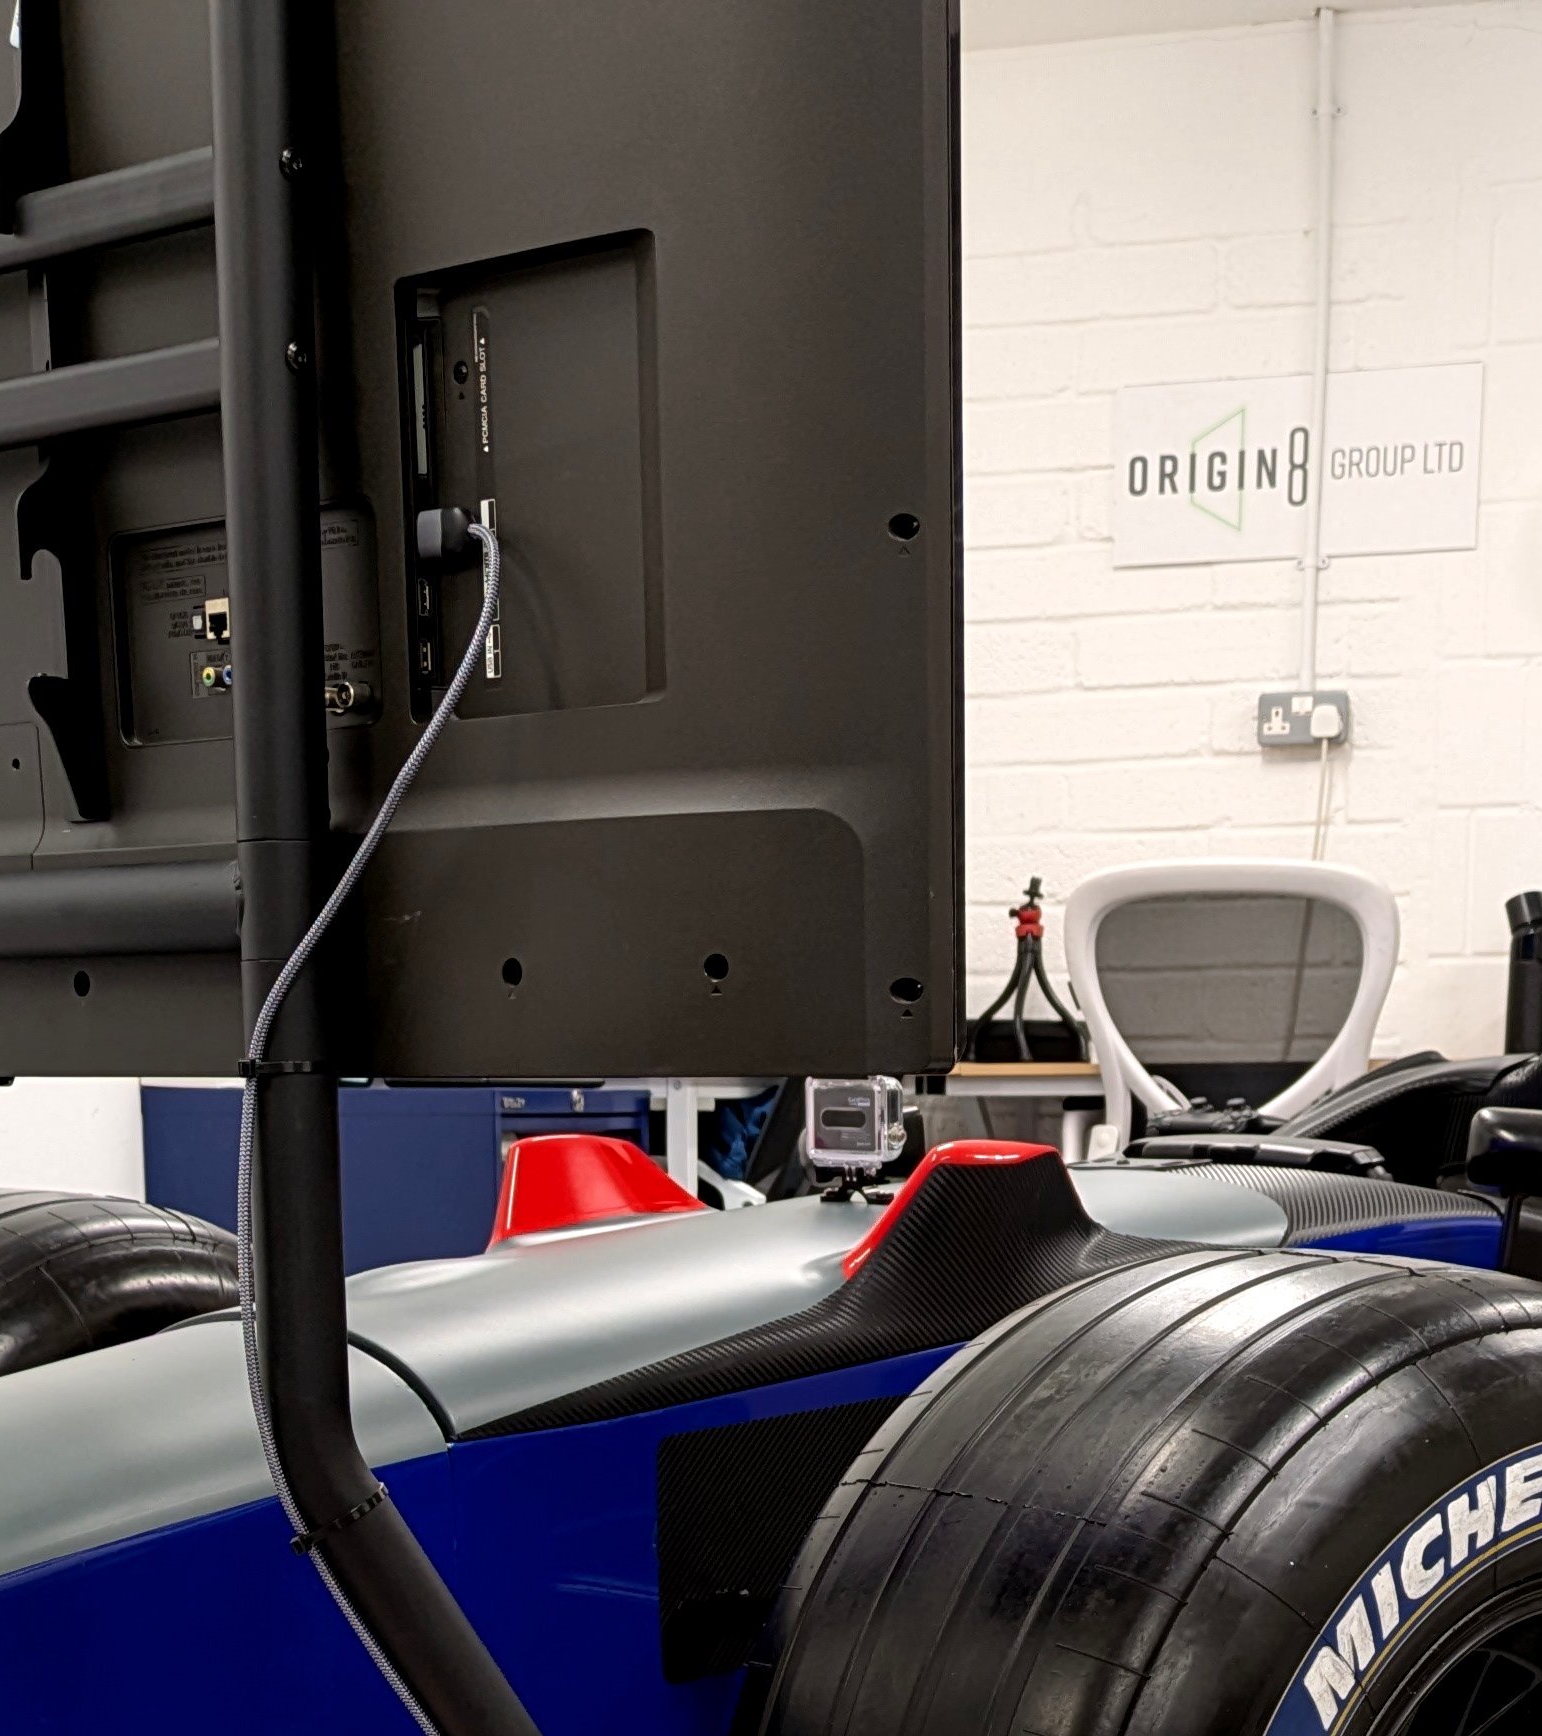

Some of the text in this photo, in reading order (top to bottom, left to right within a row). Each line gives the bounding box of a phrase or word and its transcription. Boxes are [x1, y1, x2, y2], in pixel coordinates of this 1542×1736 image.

[479, 346, 487, 373] SLOT
[480, 374, 488, 404] CARD
[1128, 426, 1464, 507] ORIGIN8 GROUP LTD
